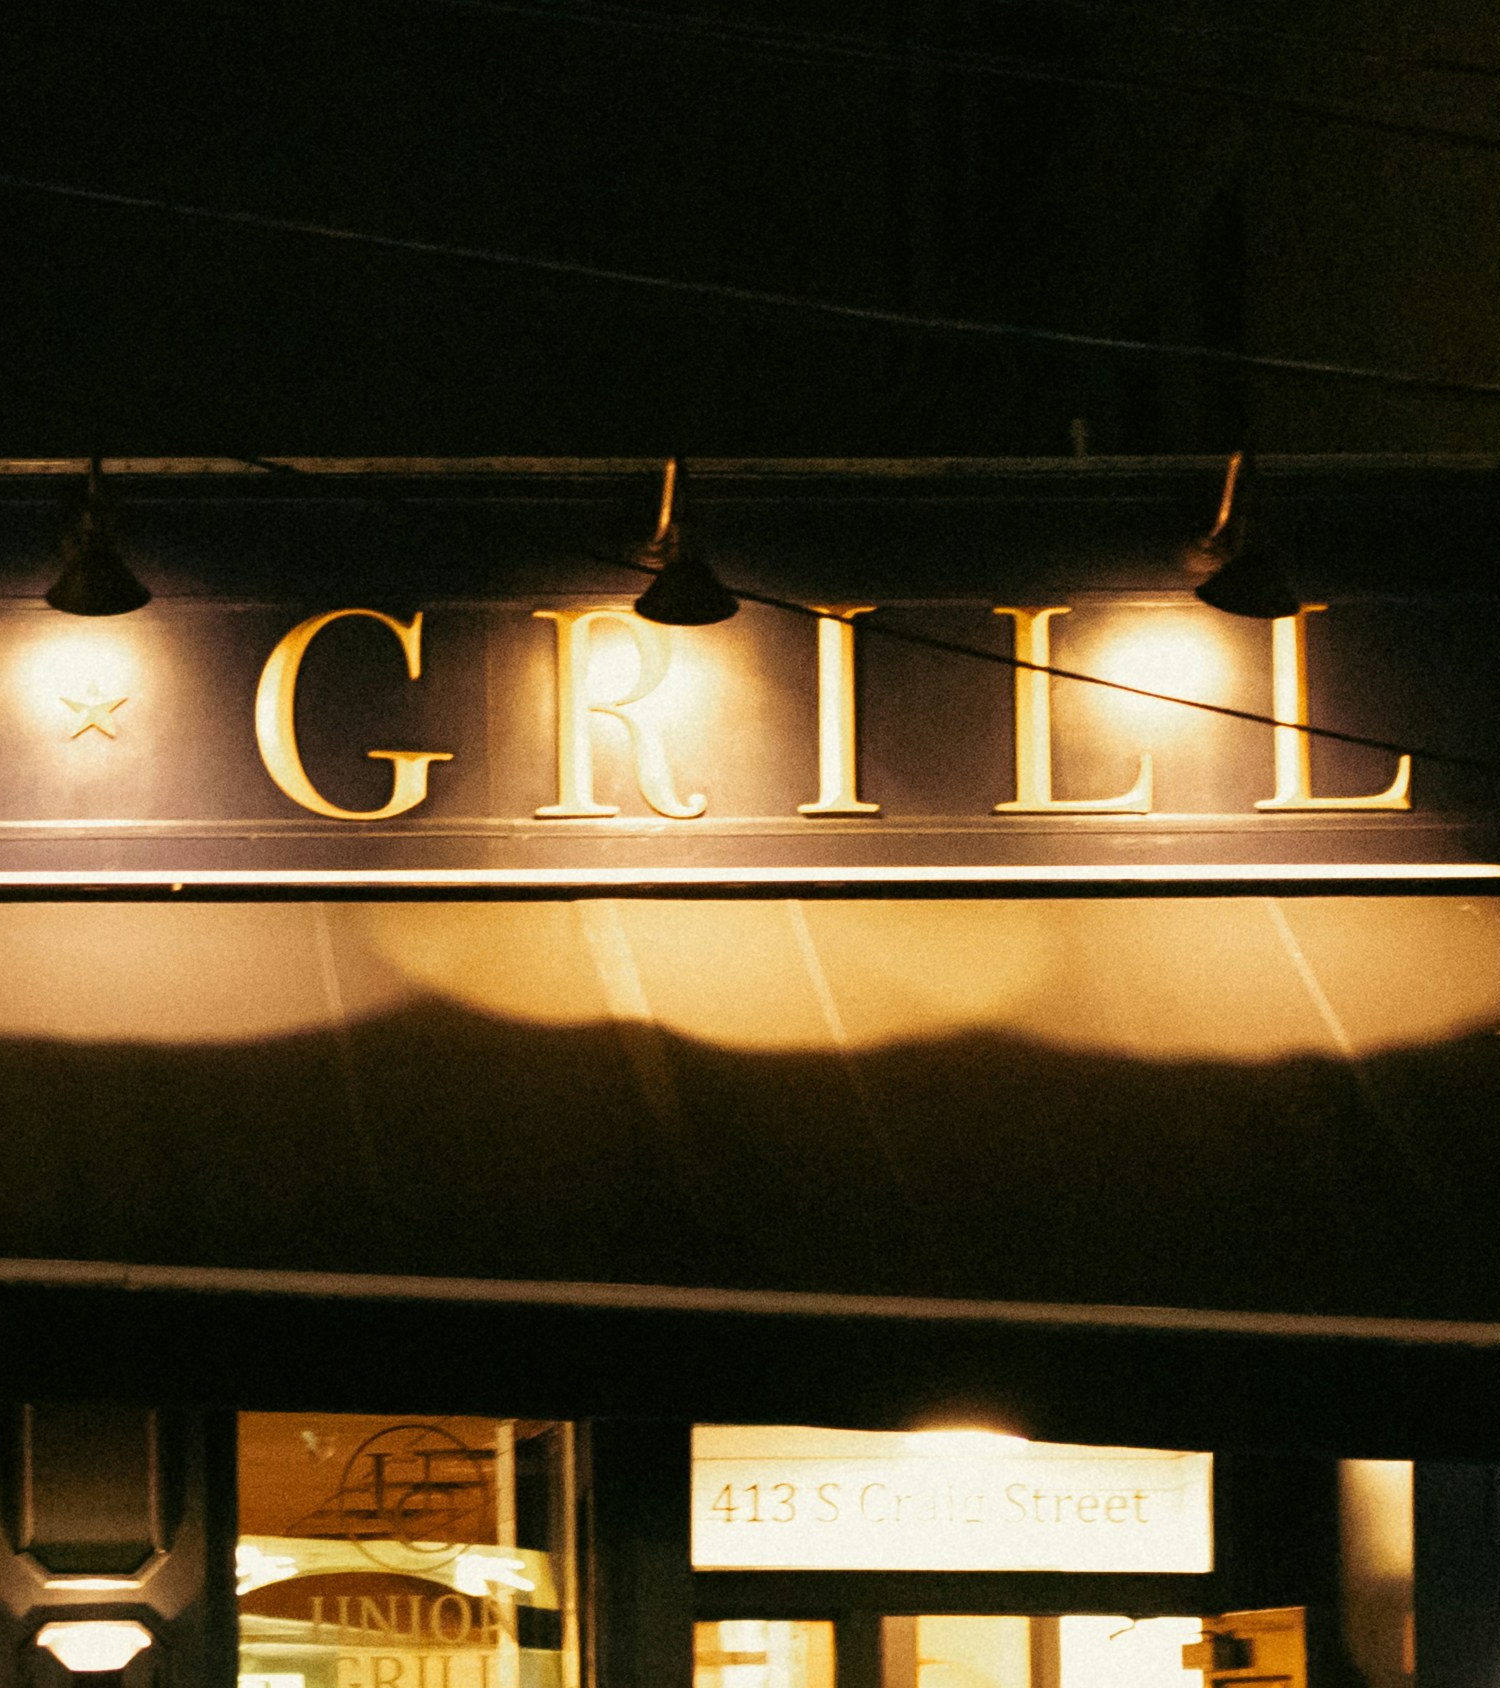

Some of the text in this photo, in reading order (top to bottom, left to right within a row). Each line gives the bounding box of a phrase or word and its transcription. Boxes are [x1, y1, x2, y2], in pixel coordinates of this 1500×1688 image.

[253, 603, 1414, 821] GRILL
[711, 1481, 798, 1524] 413
[815, 1482, 841, 1524] S
[1003, 1482, 1150, 1524] Street
